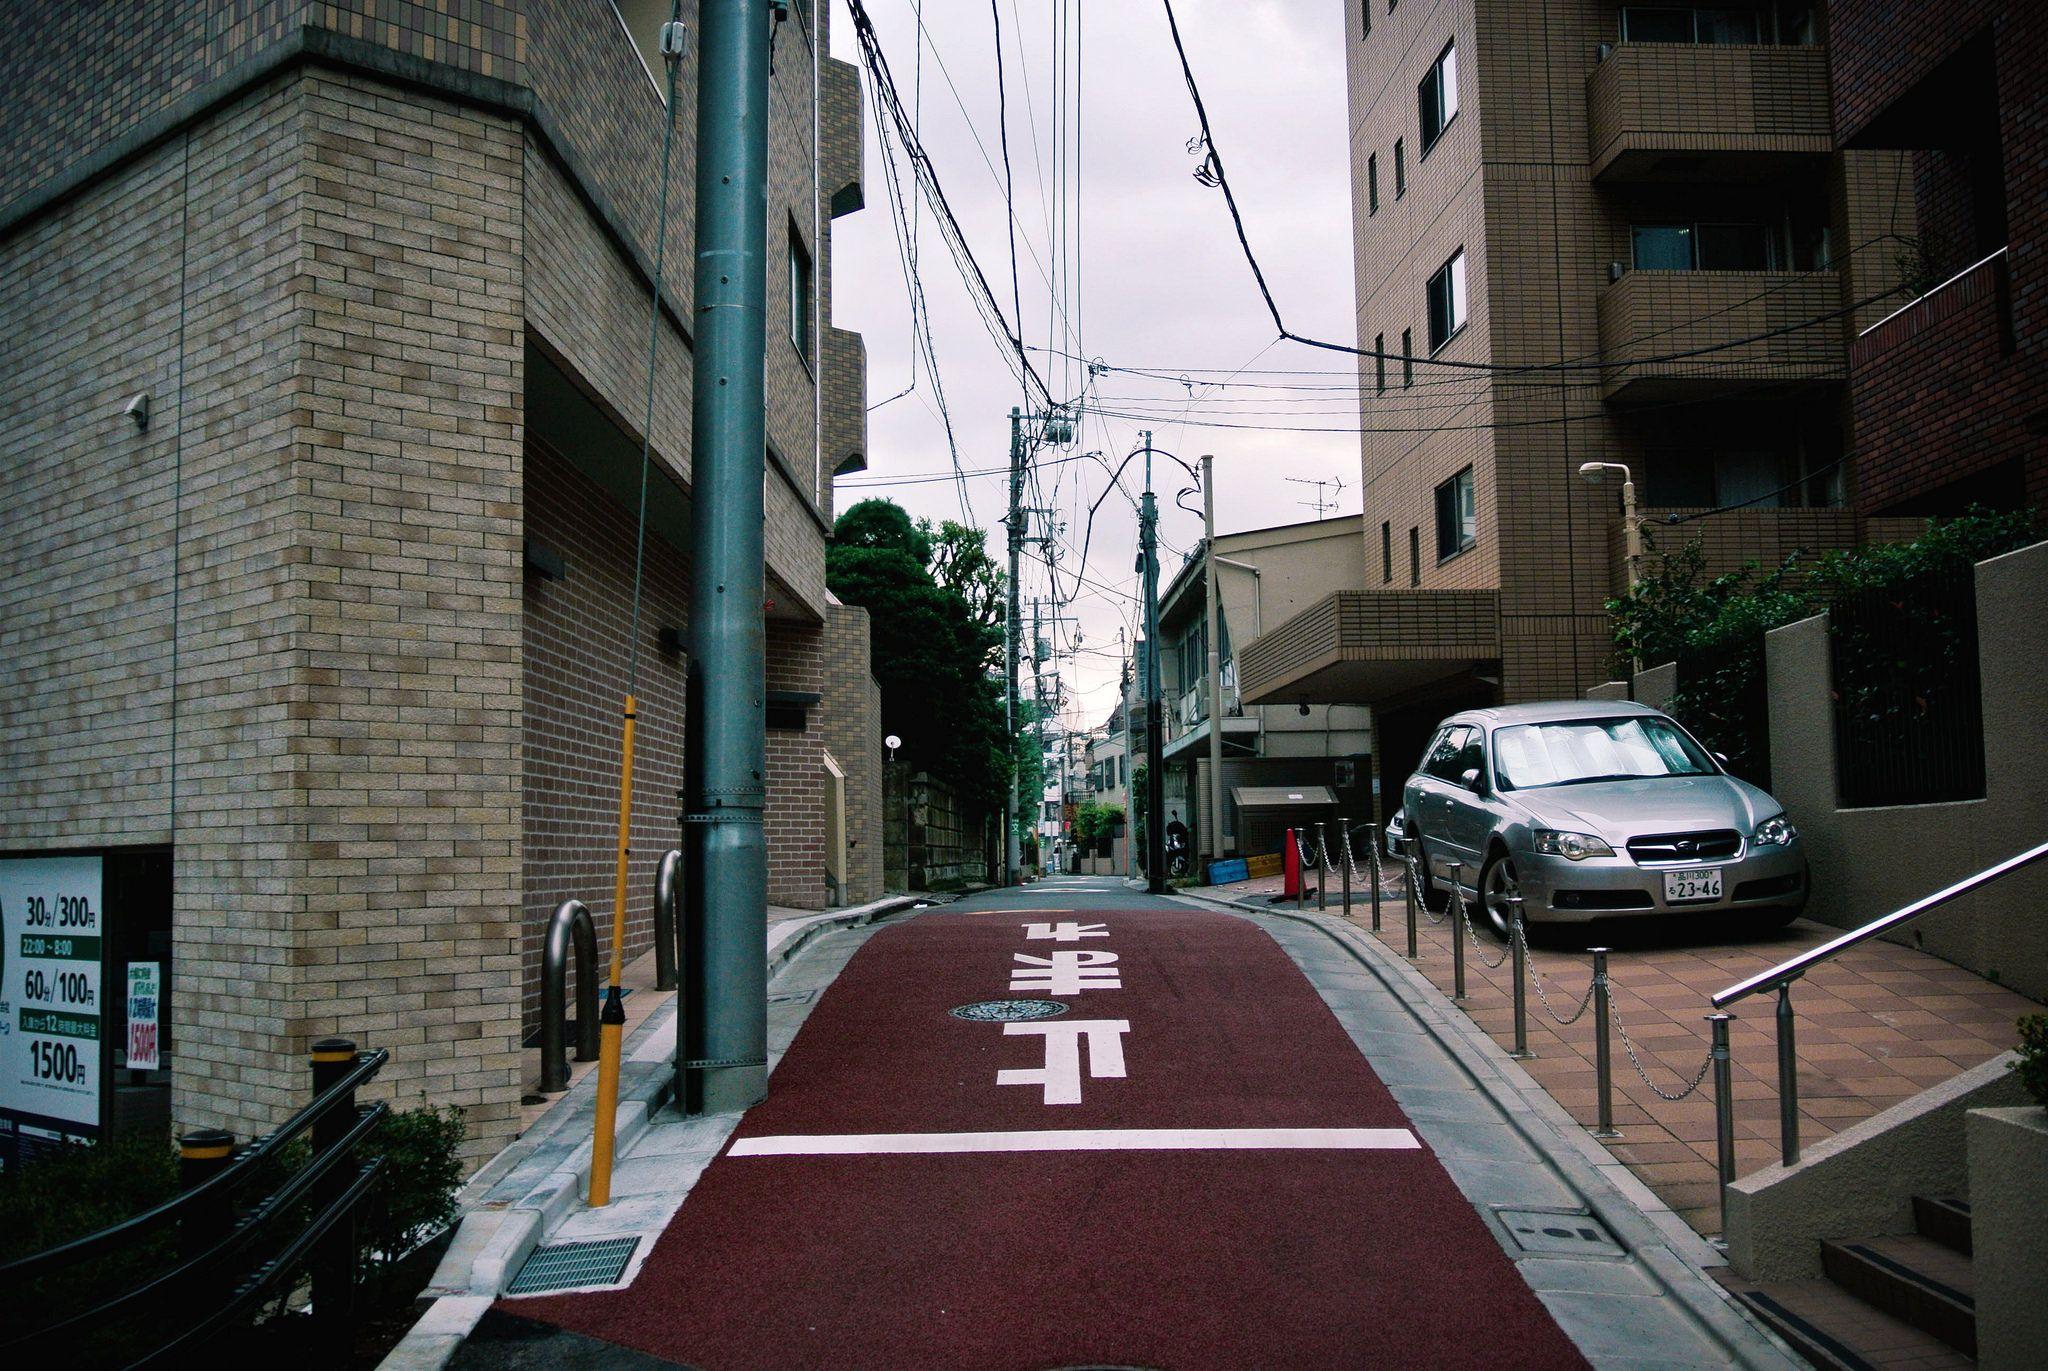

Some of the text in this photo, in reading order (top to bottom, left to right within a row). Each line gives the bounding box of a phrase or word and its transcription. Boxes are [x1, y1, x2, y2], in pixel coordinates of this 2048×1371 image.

[1677, 880, 1720, 898] 23-46
[26, 893, 96, 929] 30分/300円
[25, 968, 95, 1007] 60分/100円
[997, 922, 1131, 1105] 止まれ
[129, 1023, 157, 1063] 1500円
[30, 1040, 86, 1086] 1500円
